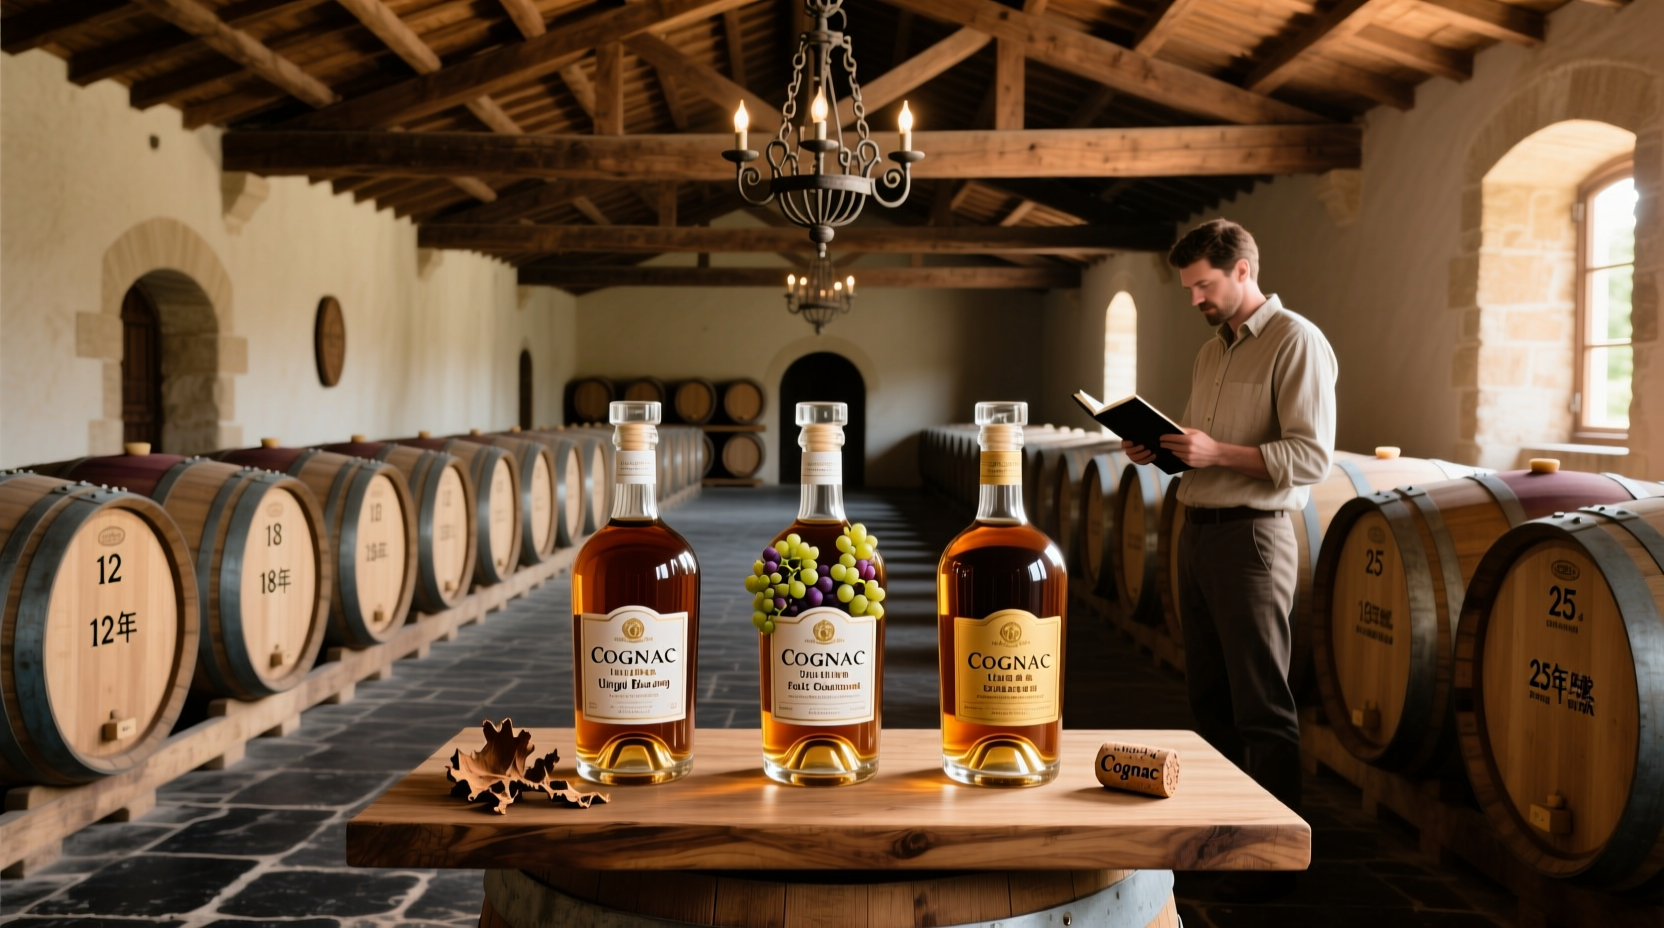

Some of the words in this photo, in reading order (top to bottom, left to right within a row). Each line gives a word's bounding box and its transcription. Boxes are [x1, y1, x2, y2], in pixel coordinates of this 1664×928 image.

[265, 522, 282, 547] 18
[96, 553, 122, 585] 12
[1365, 549, 1384, 577] 25
[260, 567, 291, 595] 18年
[1548, 585, 1577, 621] 25
[89, 610, 138, 647] 12年
[591, 646, 677, 665] COGNAC
[781, 648, 866, 667] COGNAC
[967, 652, 1052, 670] COGNAC
[1100, 754, 1160, 781] Cognac
